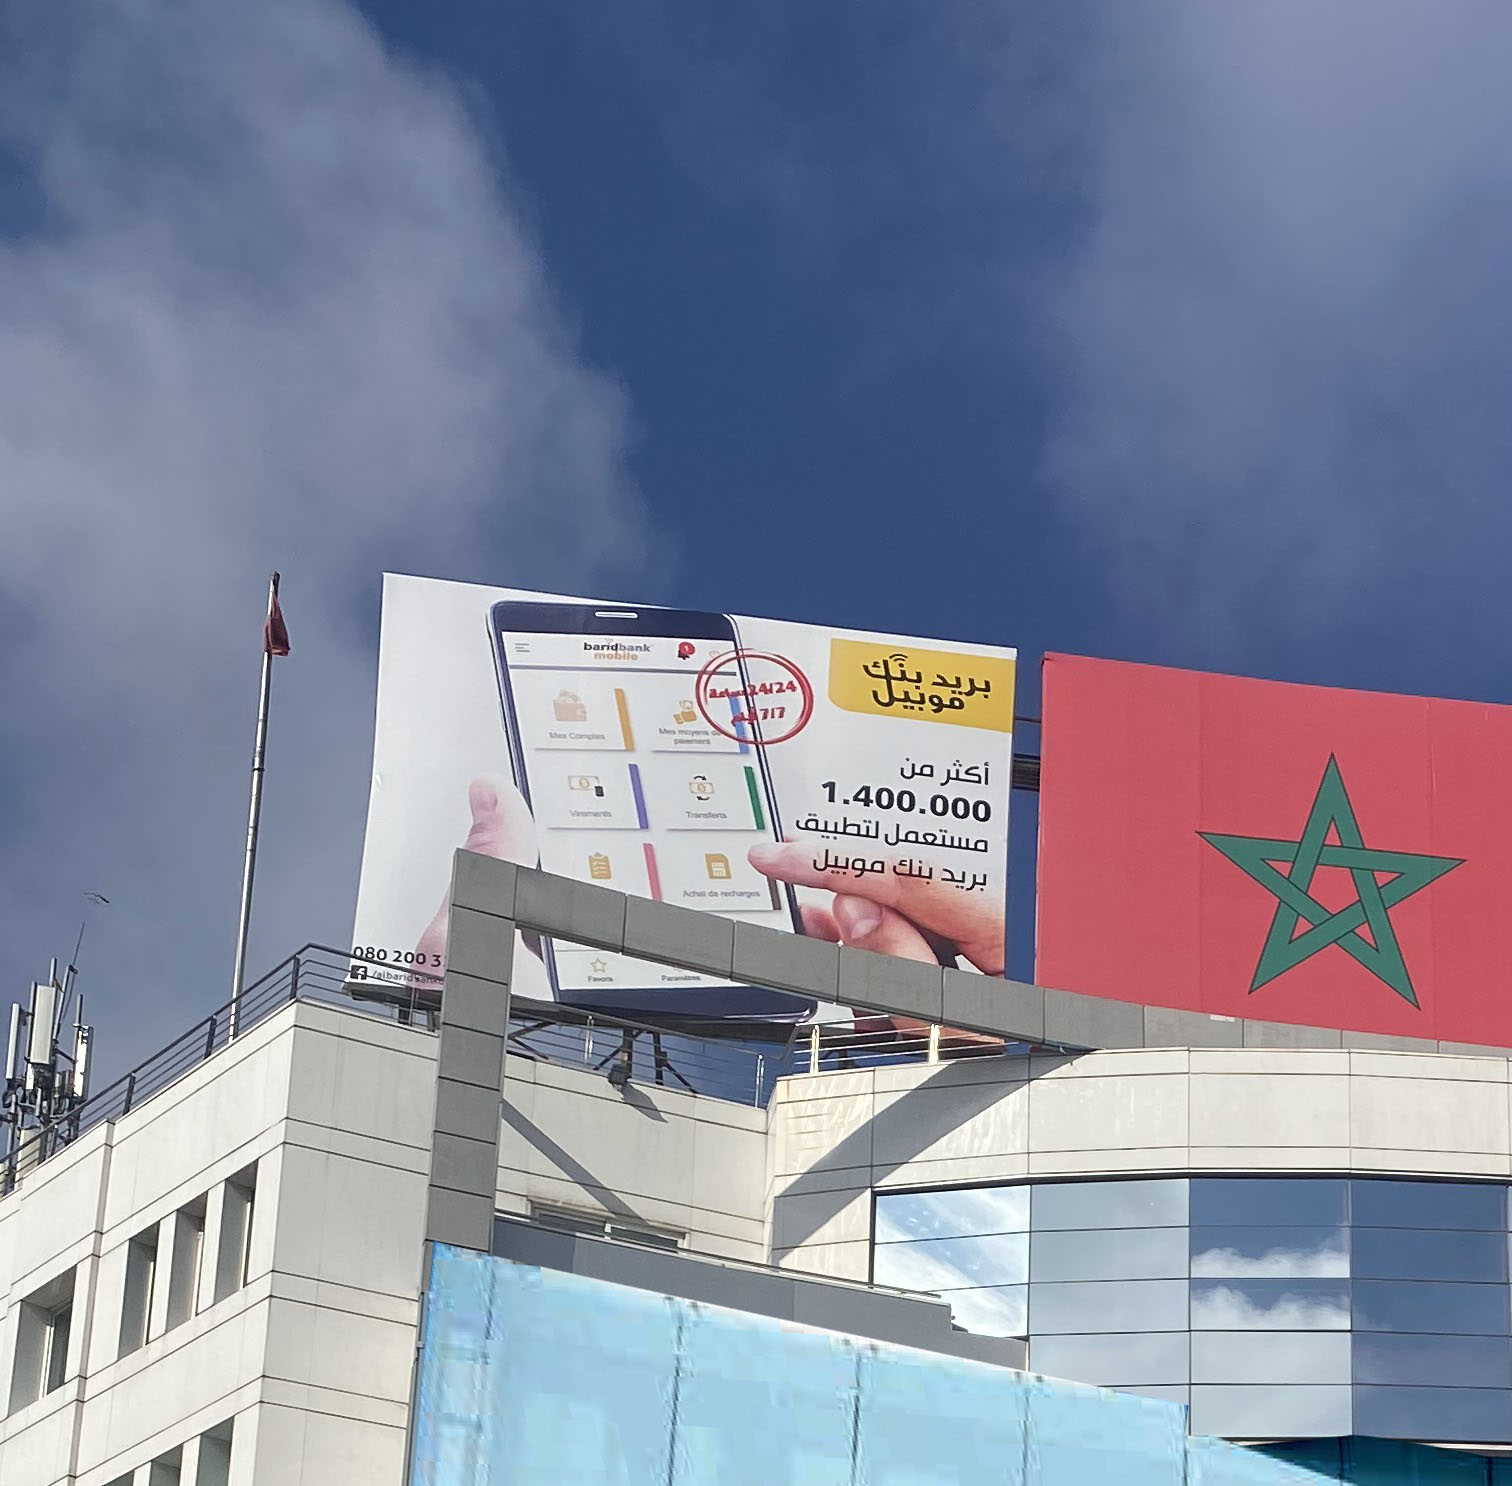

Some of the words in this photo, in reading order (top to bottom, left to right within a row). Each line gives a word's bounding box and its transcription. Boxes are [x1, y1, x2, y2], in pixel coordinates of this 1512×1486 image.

[583, 642, 651, 652] baridbank
[594, 651, 638, 661] mobile
[931, 673, 992, 699] بريد
[900, 757, 934, 779] من
[940, 760, 990, 786] أكثر
[821, 781, 992, 822] 1.400.000
[795, 813, 879, 840] لتطبيق
[884, 824, 989, 852] مستعمل
[813, 849, 885, 877] موبيل
[892, 859, 933, 885] بنك
[940, 867, 988, 891] بريد
[353, 946, 387, 961] 080
[393, 950, 426, 965] 200
